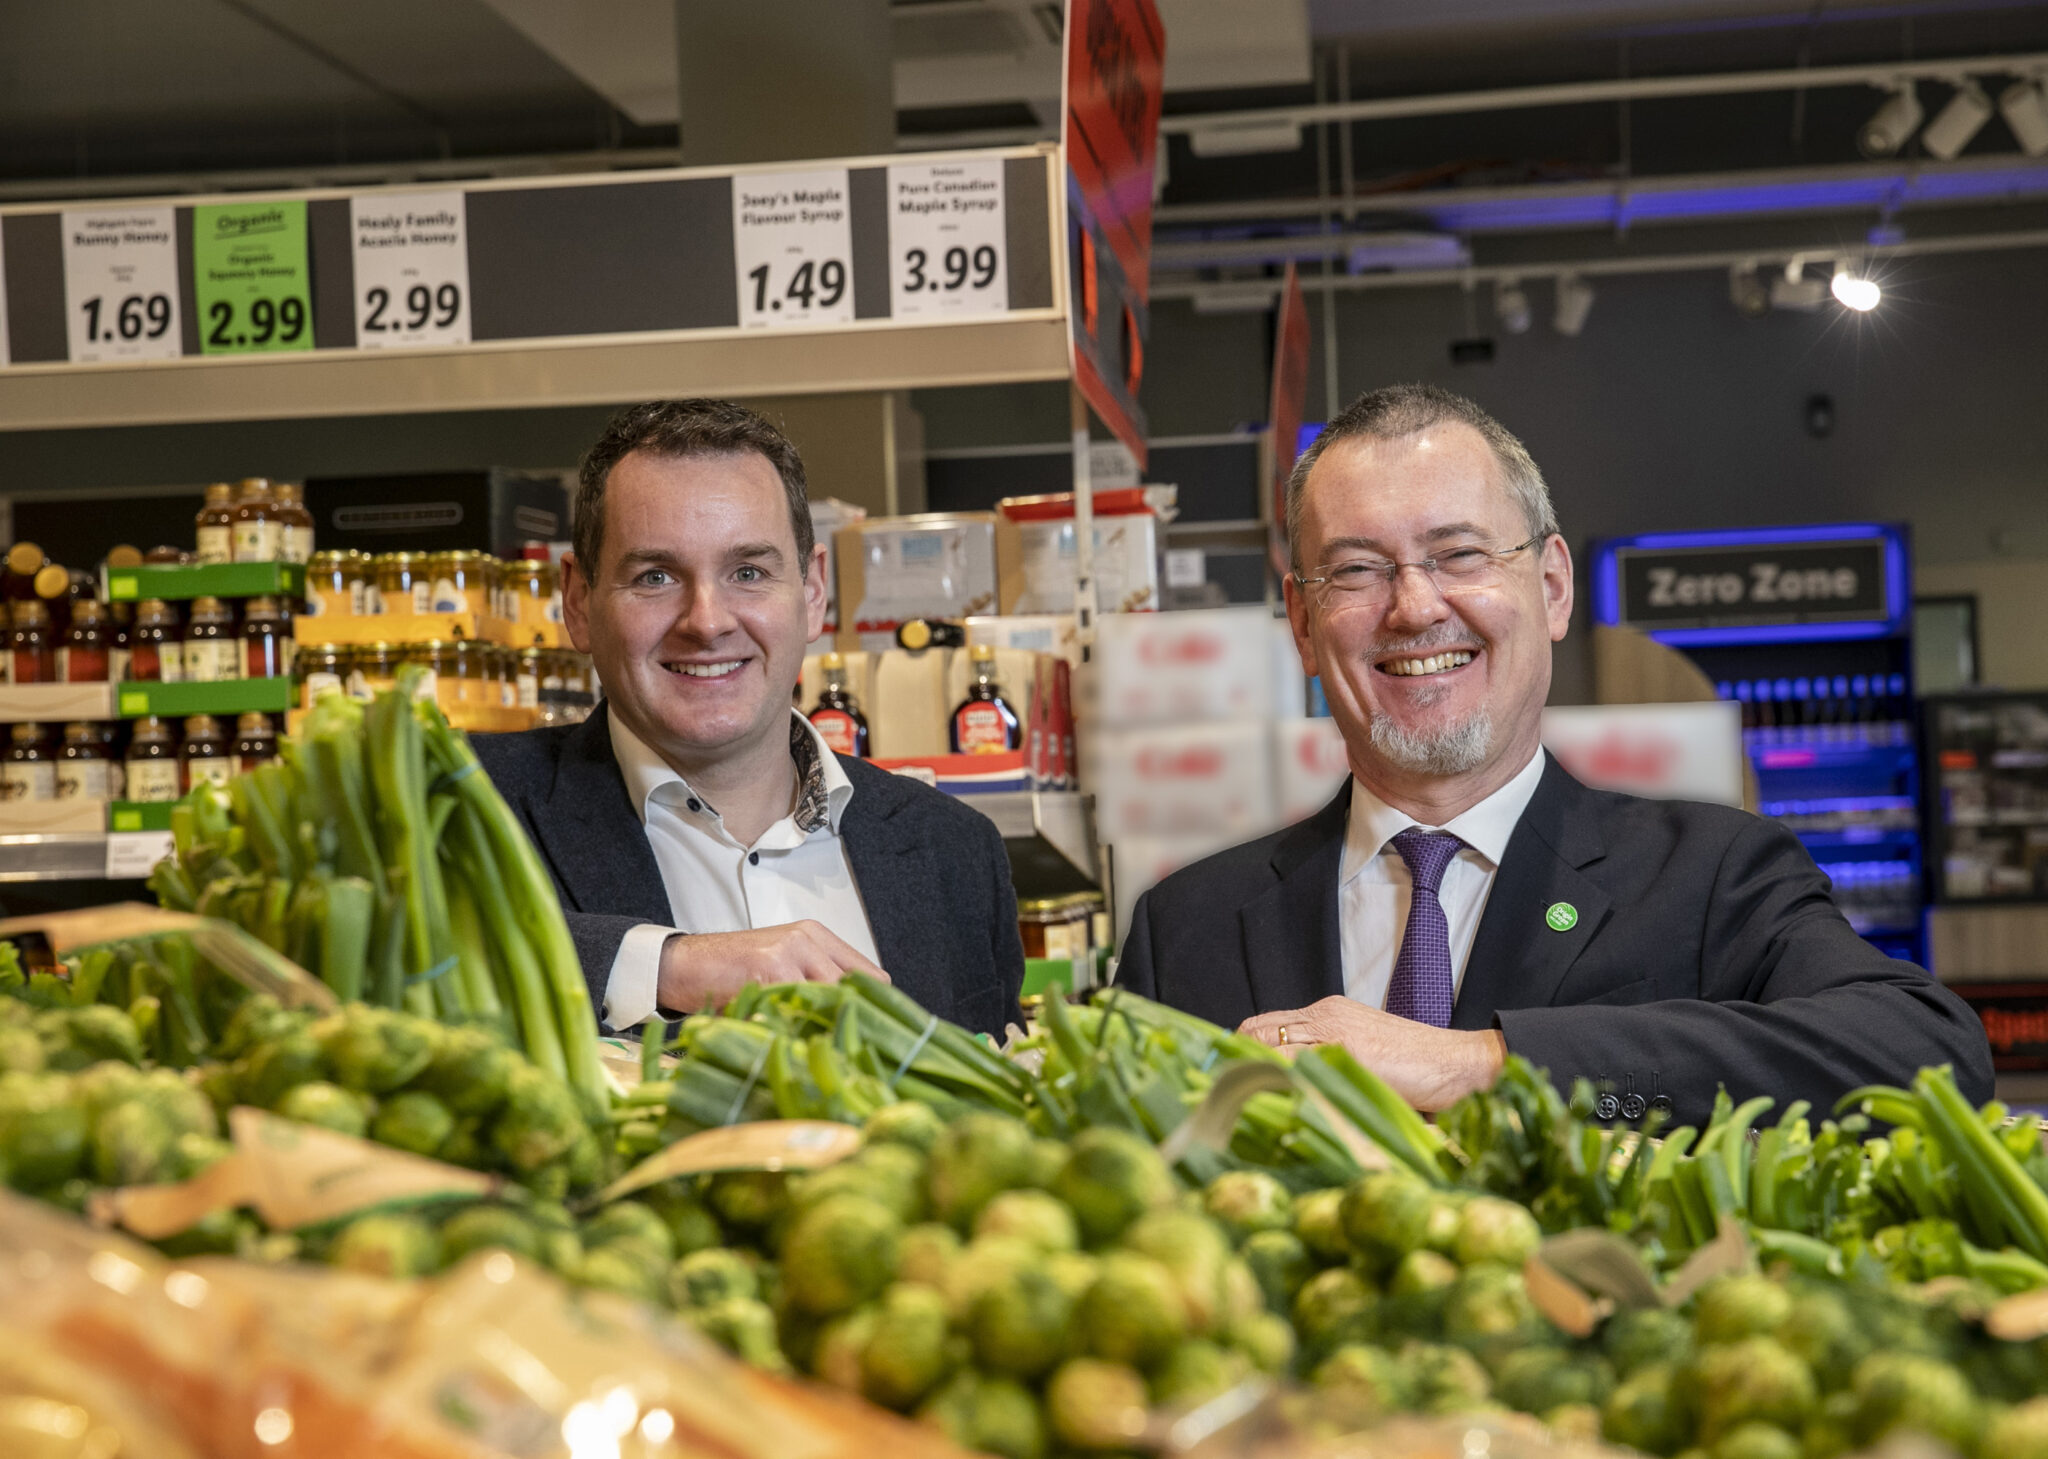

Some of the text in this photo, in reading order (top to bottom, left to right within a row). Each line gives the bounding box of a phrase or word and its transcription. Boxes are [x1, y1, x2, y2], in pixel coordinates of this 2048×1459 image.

[898, 179, 997, 195] Pure Canadian
[742, 188, 841, 209] Joey's Maple
[898, 197, 998, 216] Maple Syrup
[216, 208, 284, 234] Organic
[405, 211, 456, 228] Family
[742, 209, 844, 226] Flavour Syrup
[123, 230, 169, 247] Honey
[411, 231, 458, 245] Honey
[227, 252, 275, 267] Organic
[903, 245, 998, 293] 3.99
[748, 259, 846, 312] 1.49
[82, 292, 172, 342] 1.69
[363, 282, 461, 332] 2.99
[208, 296, 306, 347] 2.99
[1647, 562, 1858, 606] Zero Zone
